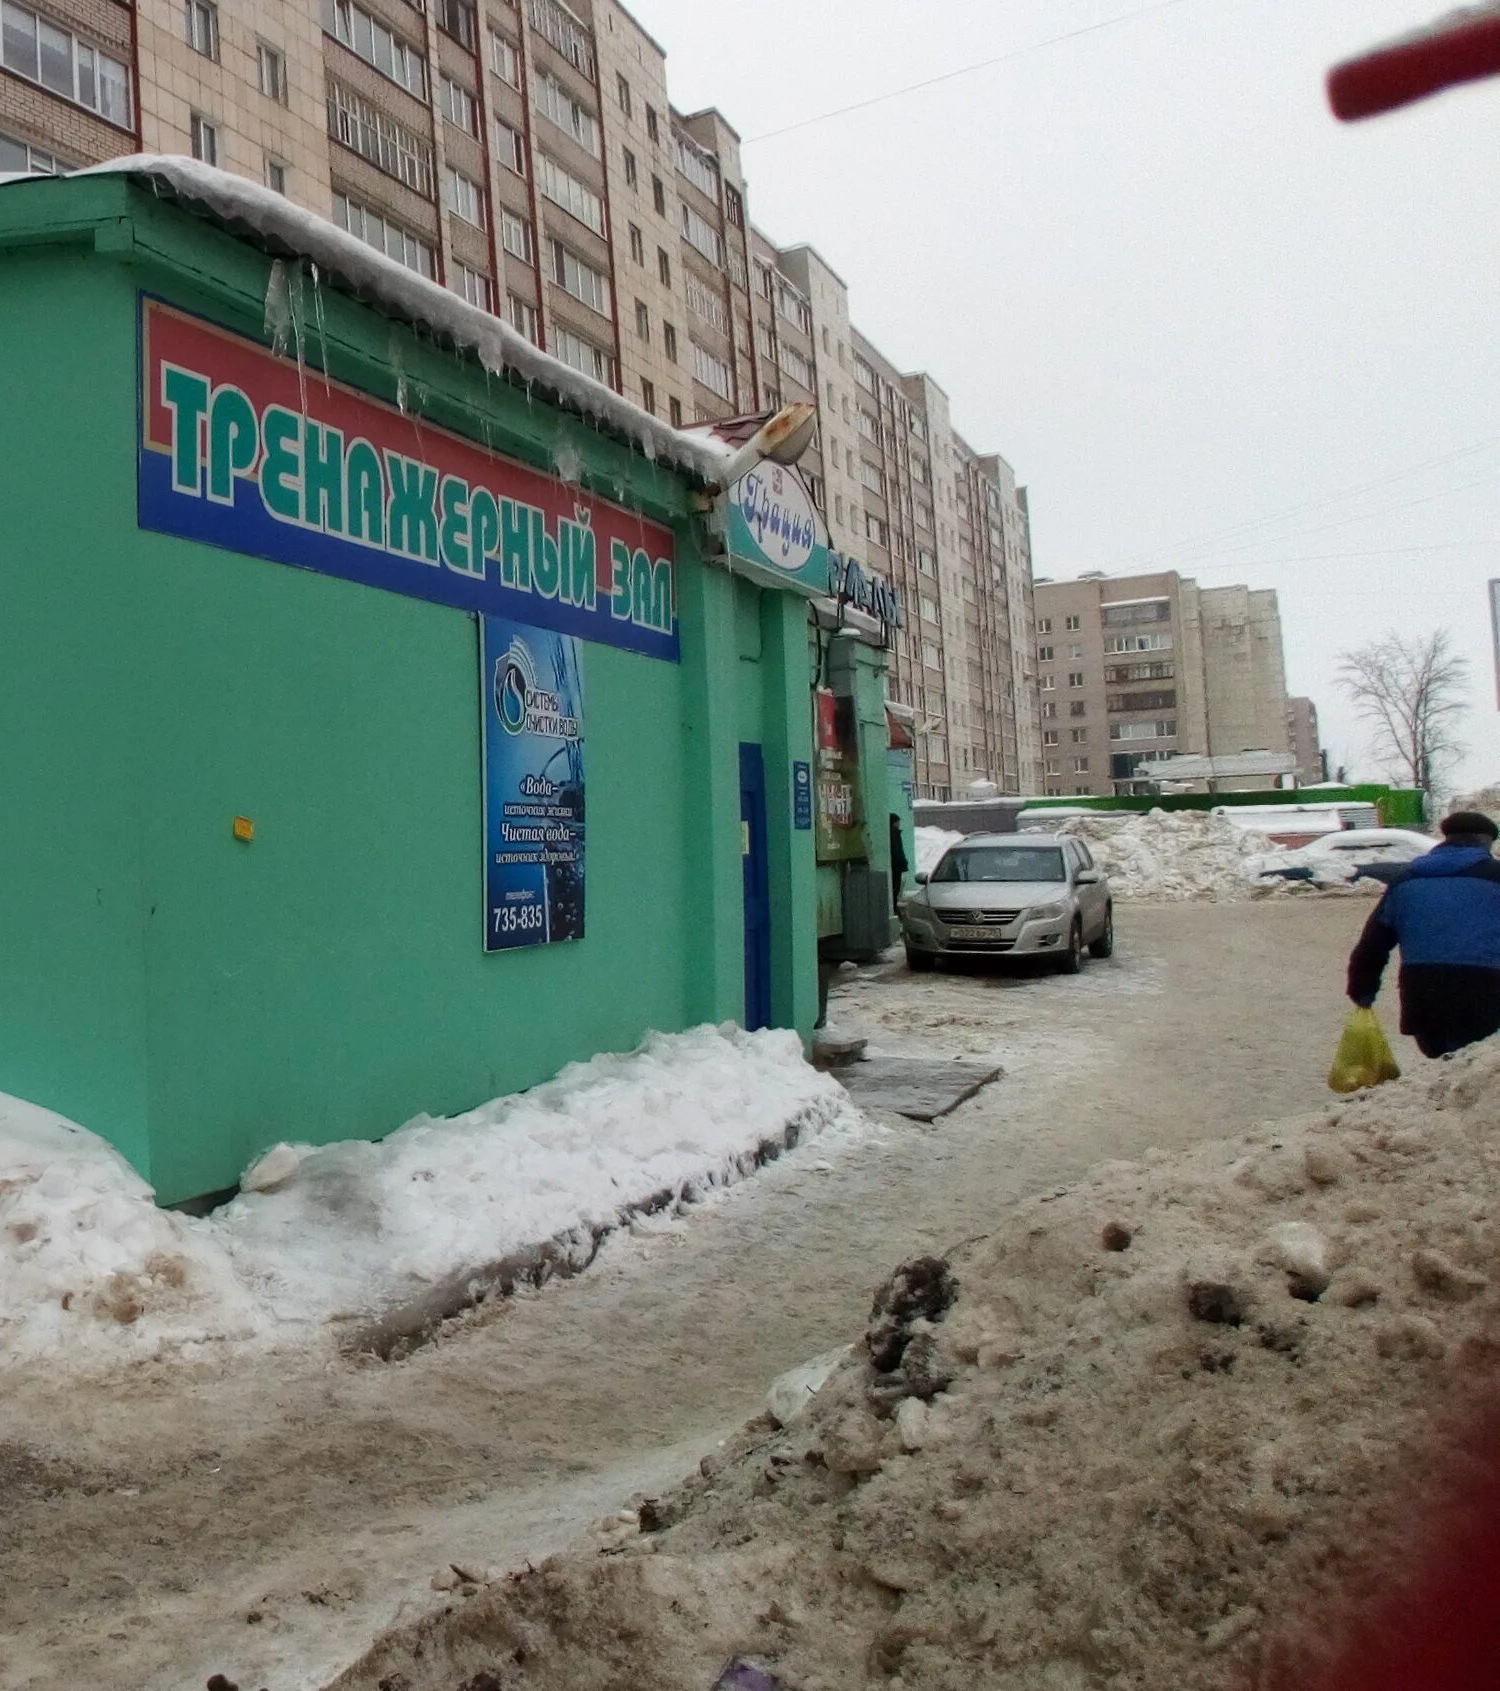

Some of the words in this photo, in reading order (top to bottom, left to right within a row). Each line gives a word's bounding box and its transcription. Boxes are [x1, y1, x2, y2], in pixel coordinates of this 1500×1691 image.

[160, 359, 598, 613] ТРЕНАЖЕРНЫЙ
[610, 536, 674, 637] ЗАЛ
[501, 823, 545, 842] Чистая
[493, 904, 543, 933] 735-835
